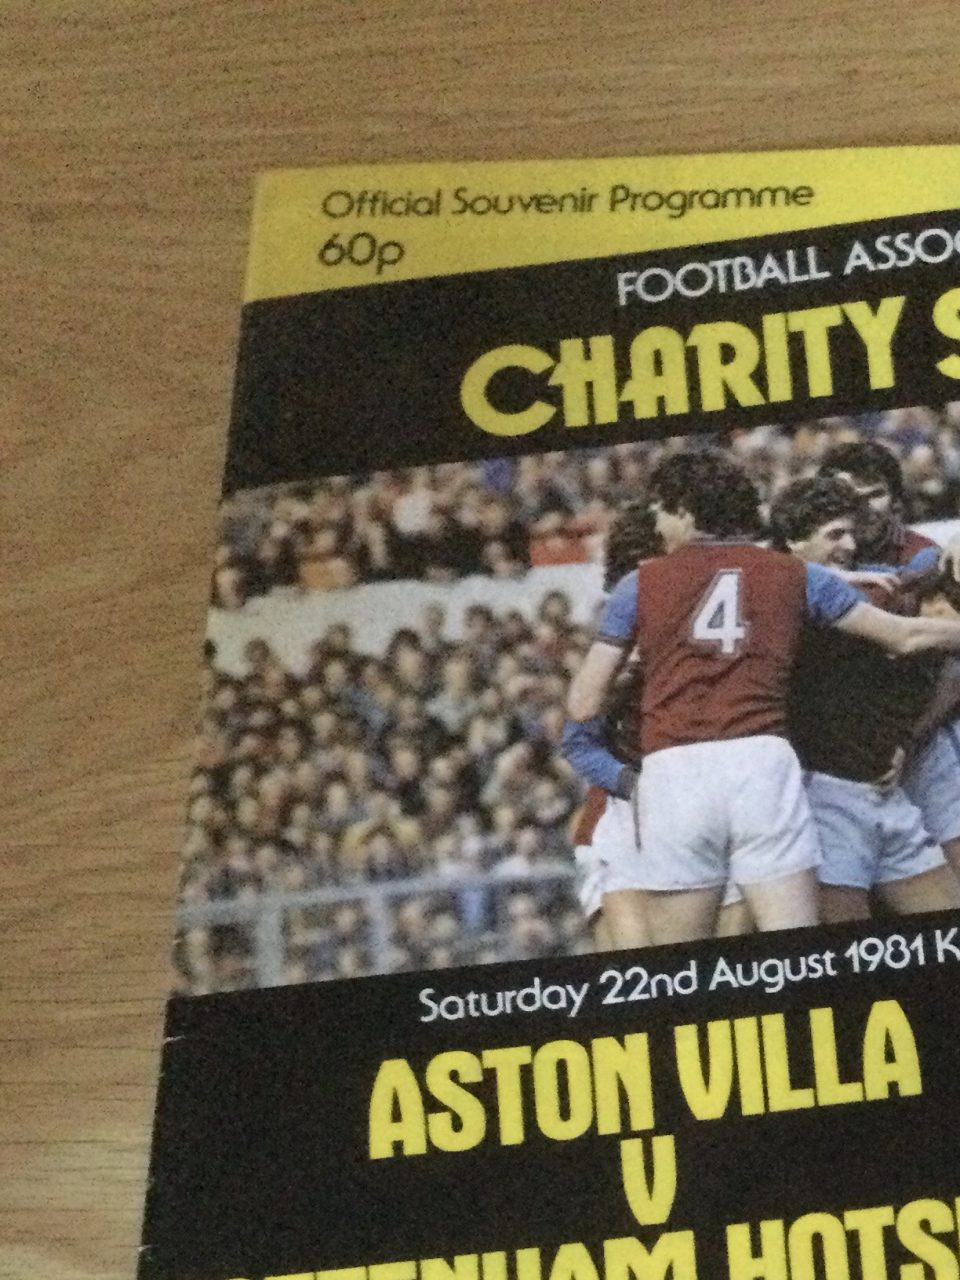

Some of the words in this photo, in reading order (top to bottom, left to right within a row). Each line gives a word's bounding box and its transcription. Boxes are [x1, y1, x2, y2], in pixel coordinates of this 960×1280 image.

[320, 188, 443, 219] Official
[451, 185, 600, 216] Souvenir
[609, 183, 815, 219] Programme
[317, 231, 406, 276] 60p
[616, 246, 831, 306] FOOTBALL
[460, 296, 906, 437] CHARITY
[689, 566, 750, 658] 4
[419, 976, 590, 1023] Saturday
[599, 959, 699, 1006] 22nd
[708, 948, 838, 994] August
[844, 932, 927, 974] 1981
[368, 1032, 655, 1160] ASTON
[674, 999, 923, 1121] VILLA
